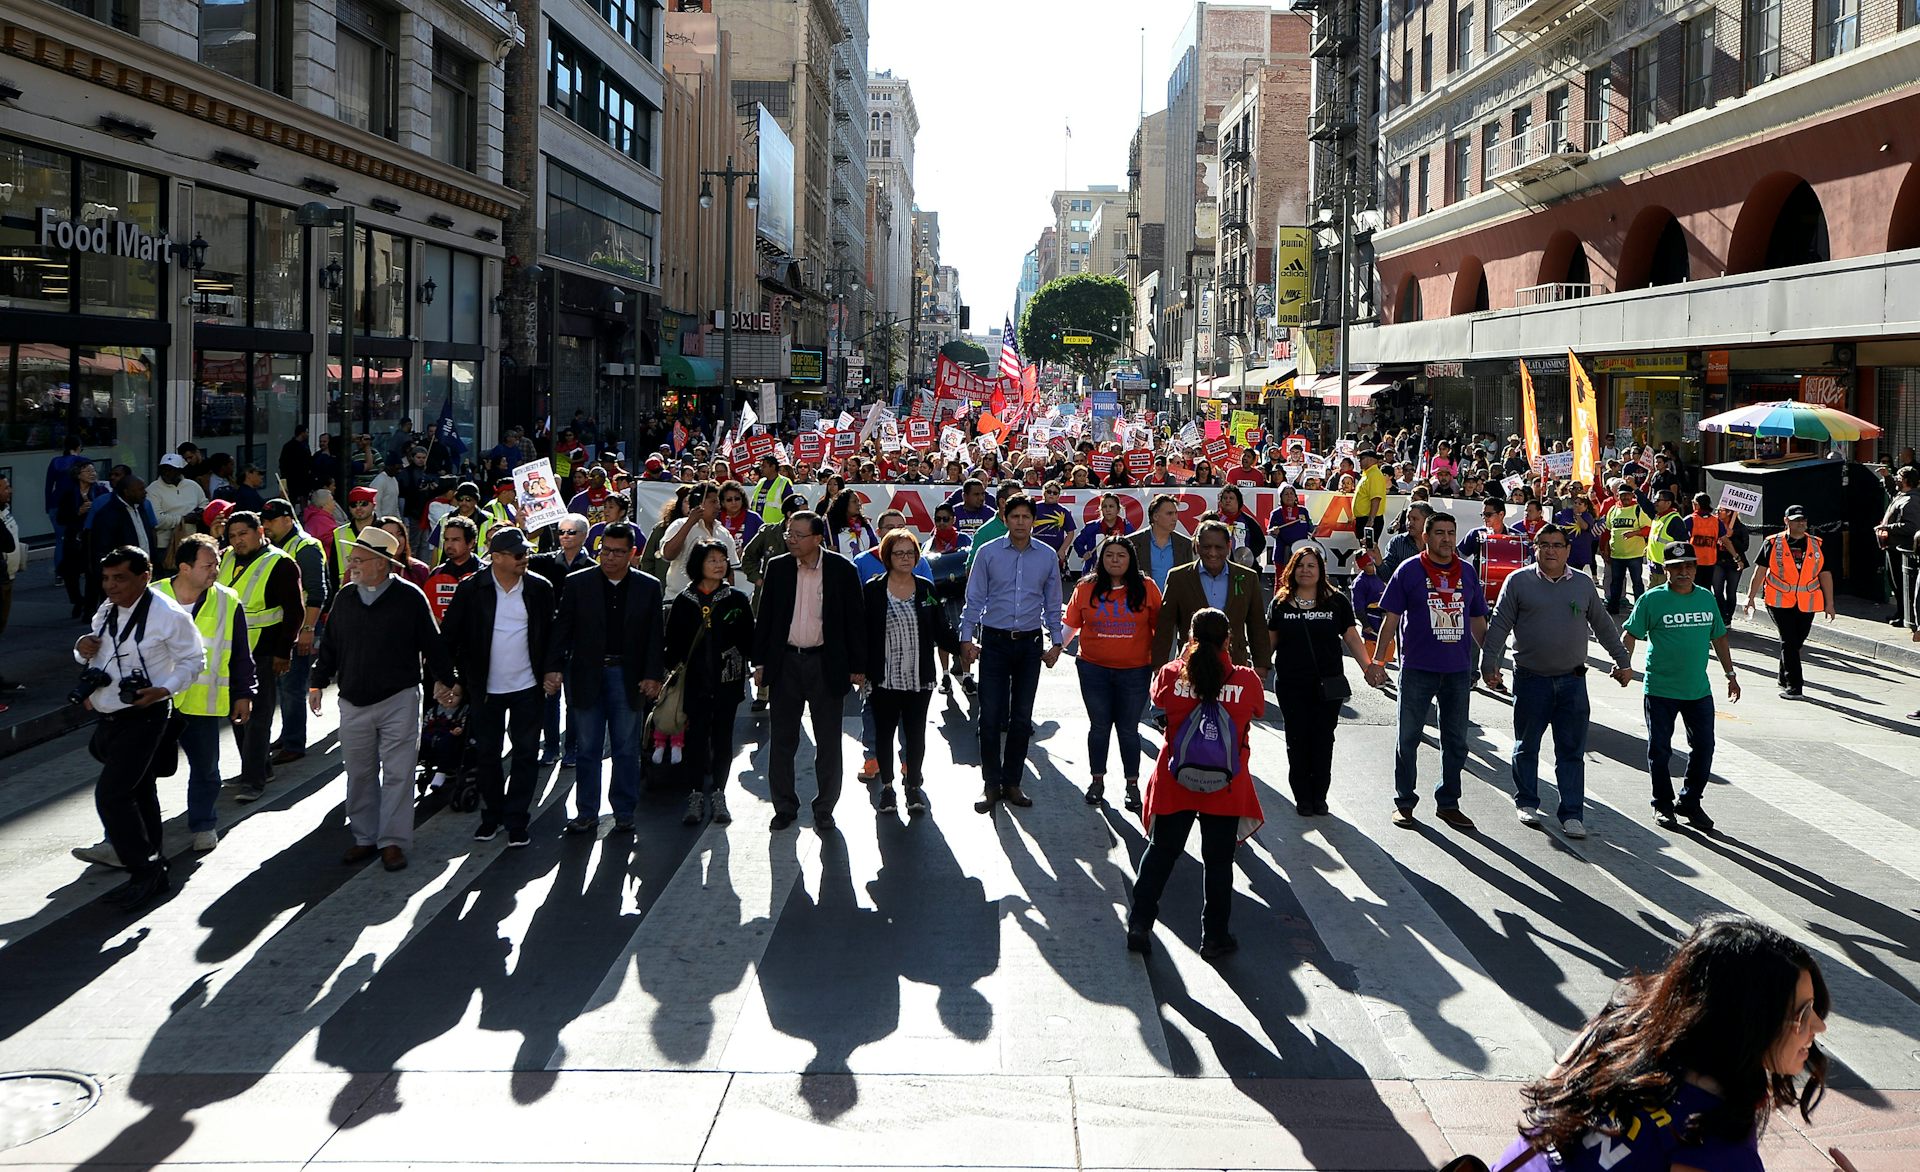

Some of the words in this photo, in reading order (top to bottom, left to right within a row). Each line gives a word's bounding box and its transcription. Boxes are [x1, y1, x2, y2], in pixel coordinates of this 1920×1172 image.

[41, 207, 107, 254] Food
[116, 221, 172, 263] Mart
[1285, 290, 1302, 298] NIKE
[1265, 388, 1288, 397] NIKE
[525, 463, 539, 472] LIBERTY
[1728, 488, 1758, 502] FEARLESS
[1728, 499, 1754, 513] UNITED
[1662, 612, 1714, 624] COFEM
